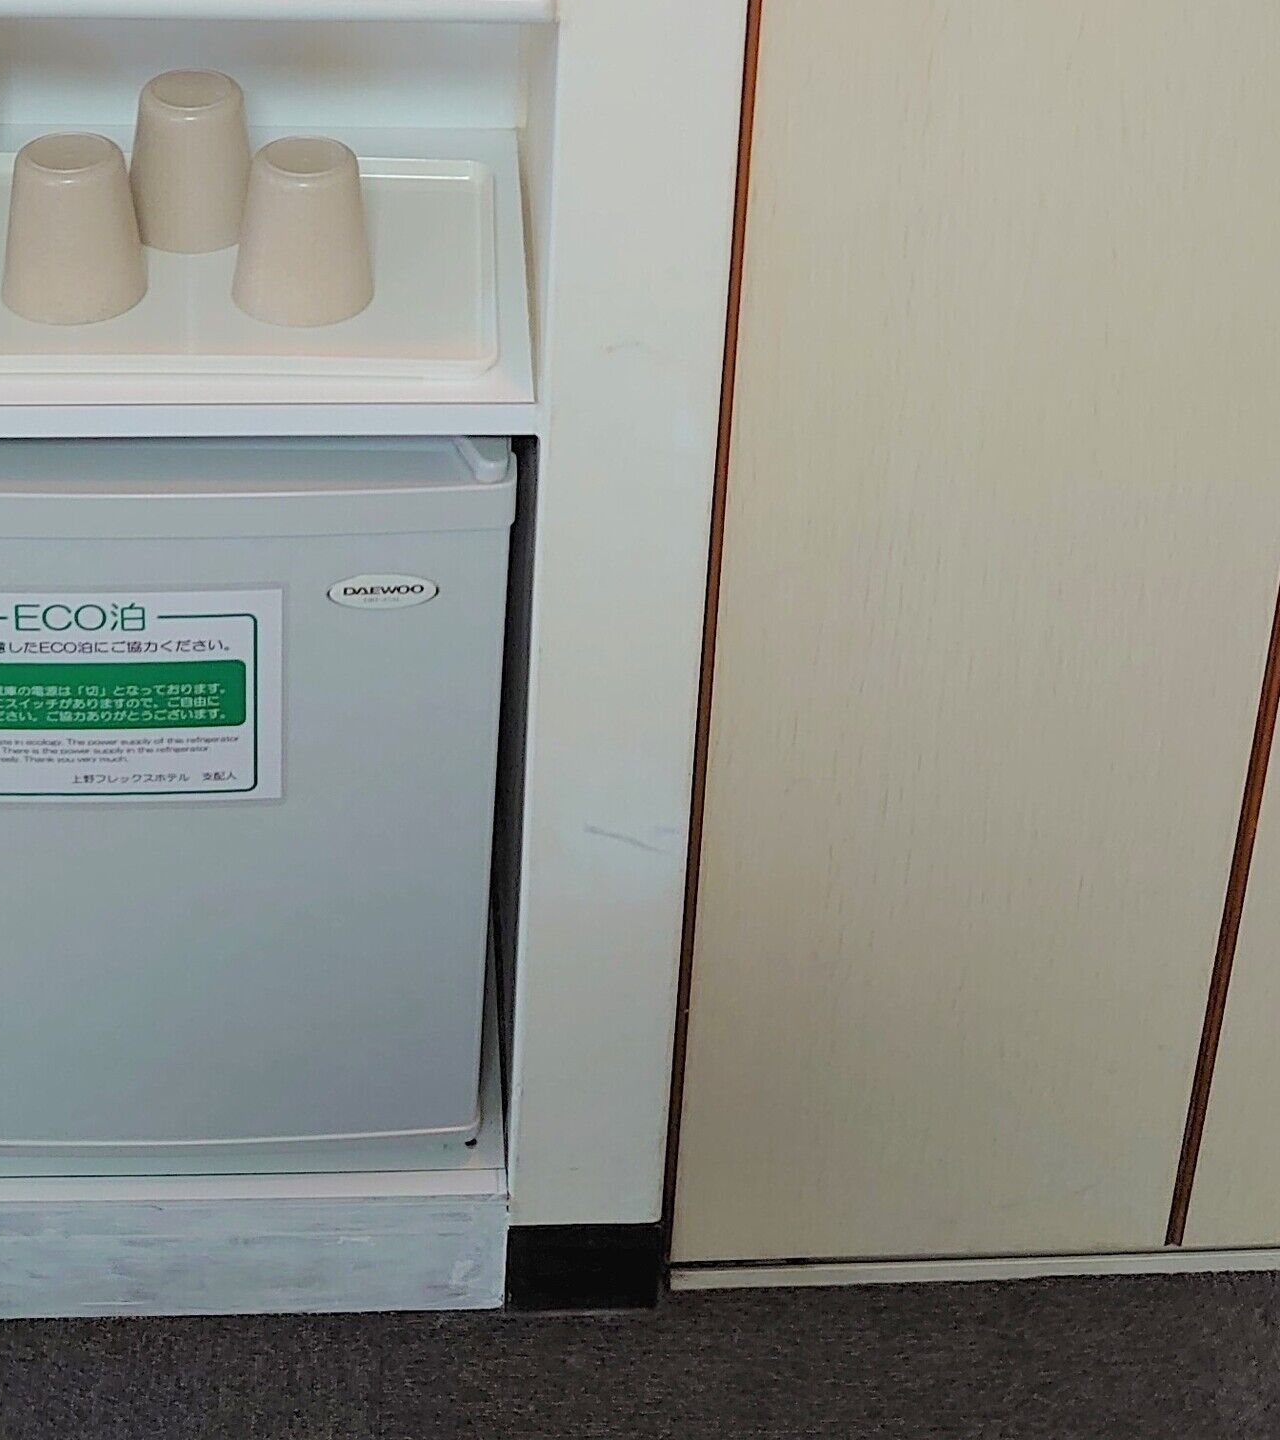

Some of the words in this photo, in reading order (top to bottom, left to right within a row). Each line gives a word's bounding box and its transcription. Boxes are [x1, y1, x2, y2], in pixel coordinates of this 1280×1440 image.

[343, 584, 425, 596] DAEWOO
[14, 602, 146, 632] ECO泊
[72, 773, 191, 785] 上野フレックスホテル
